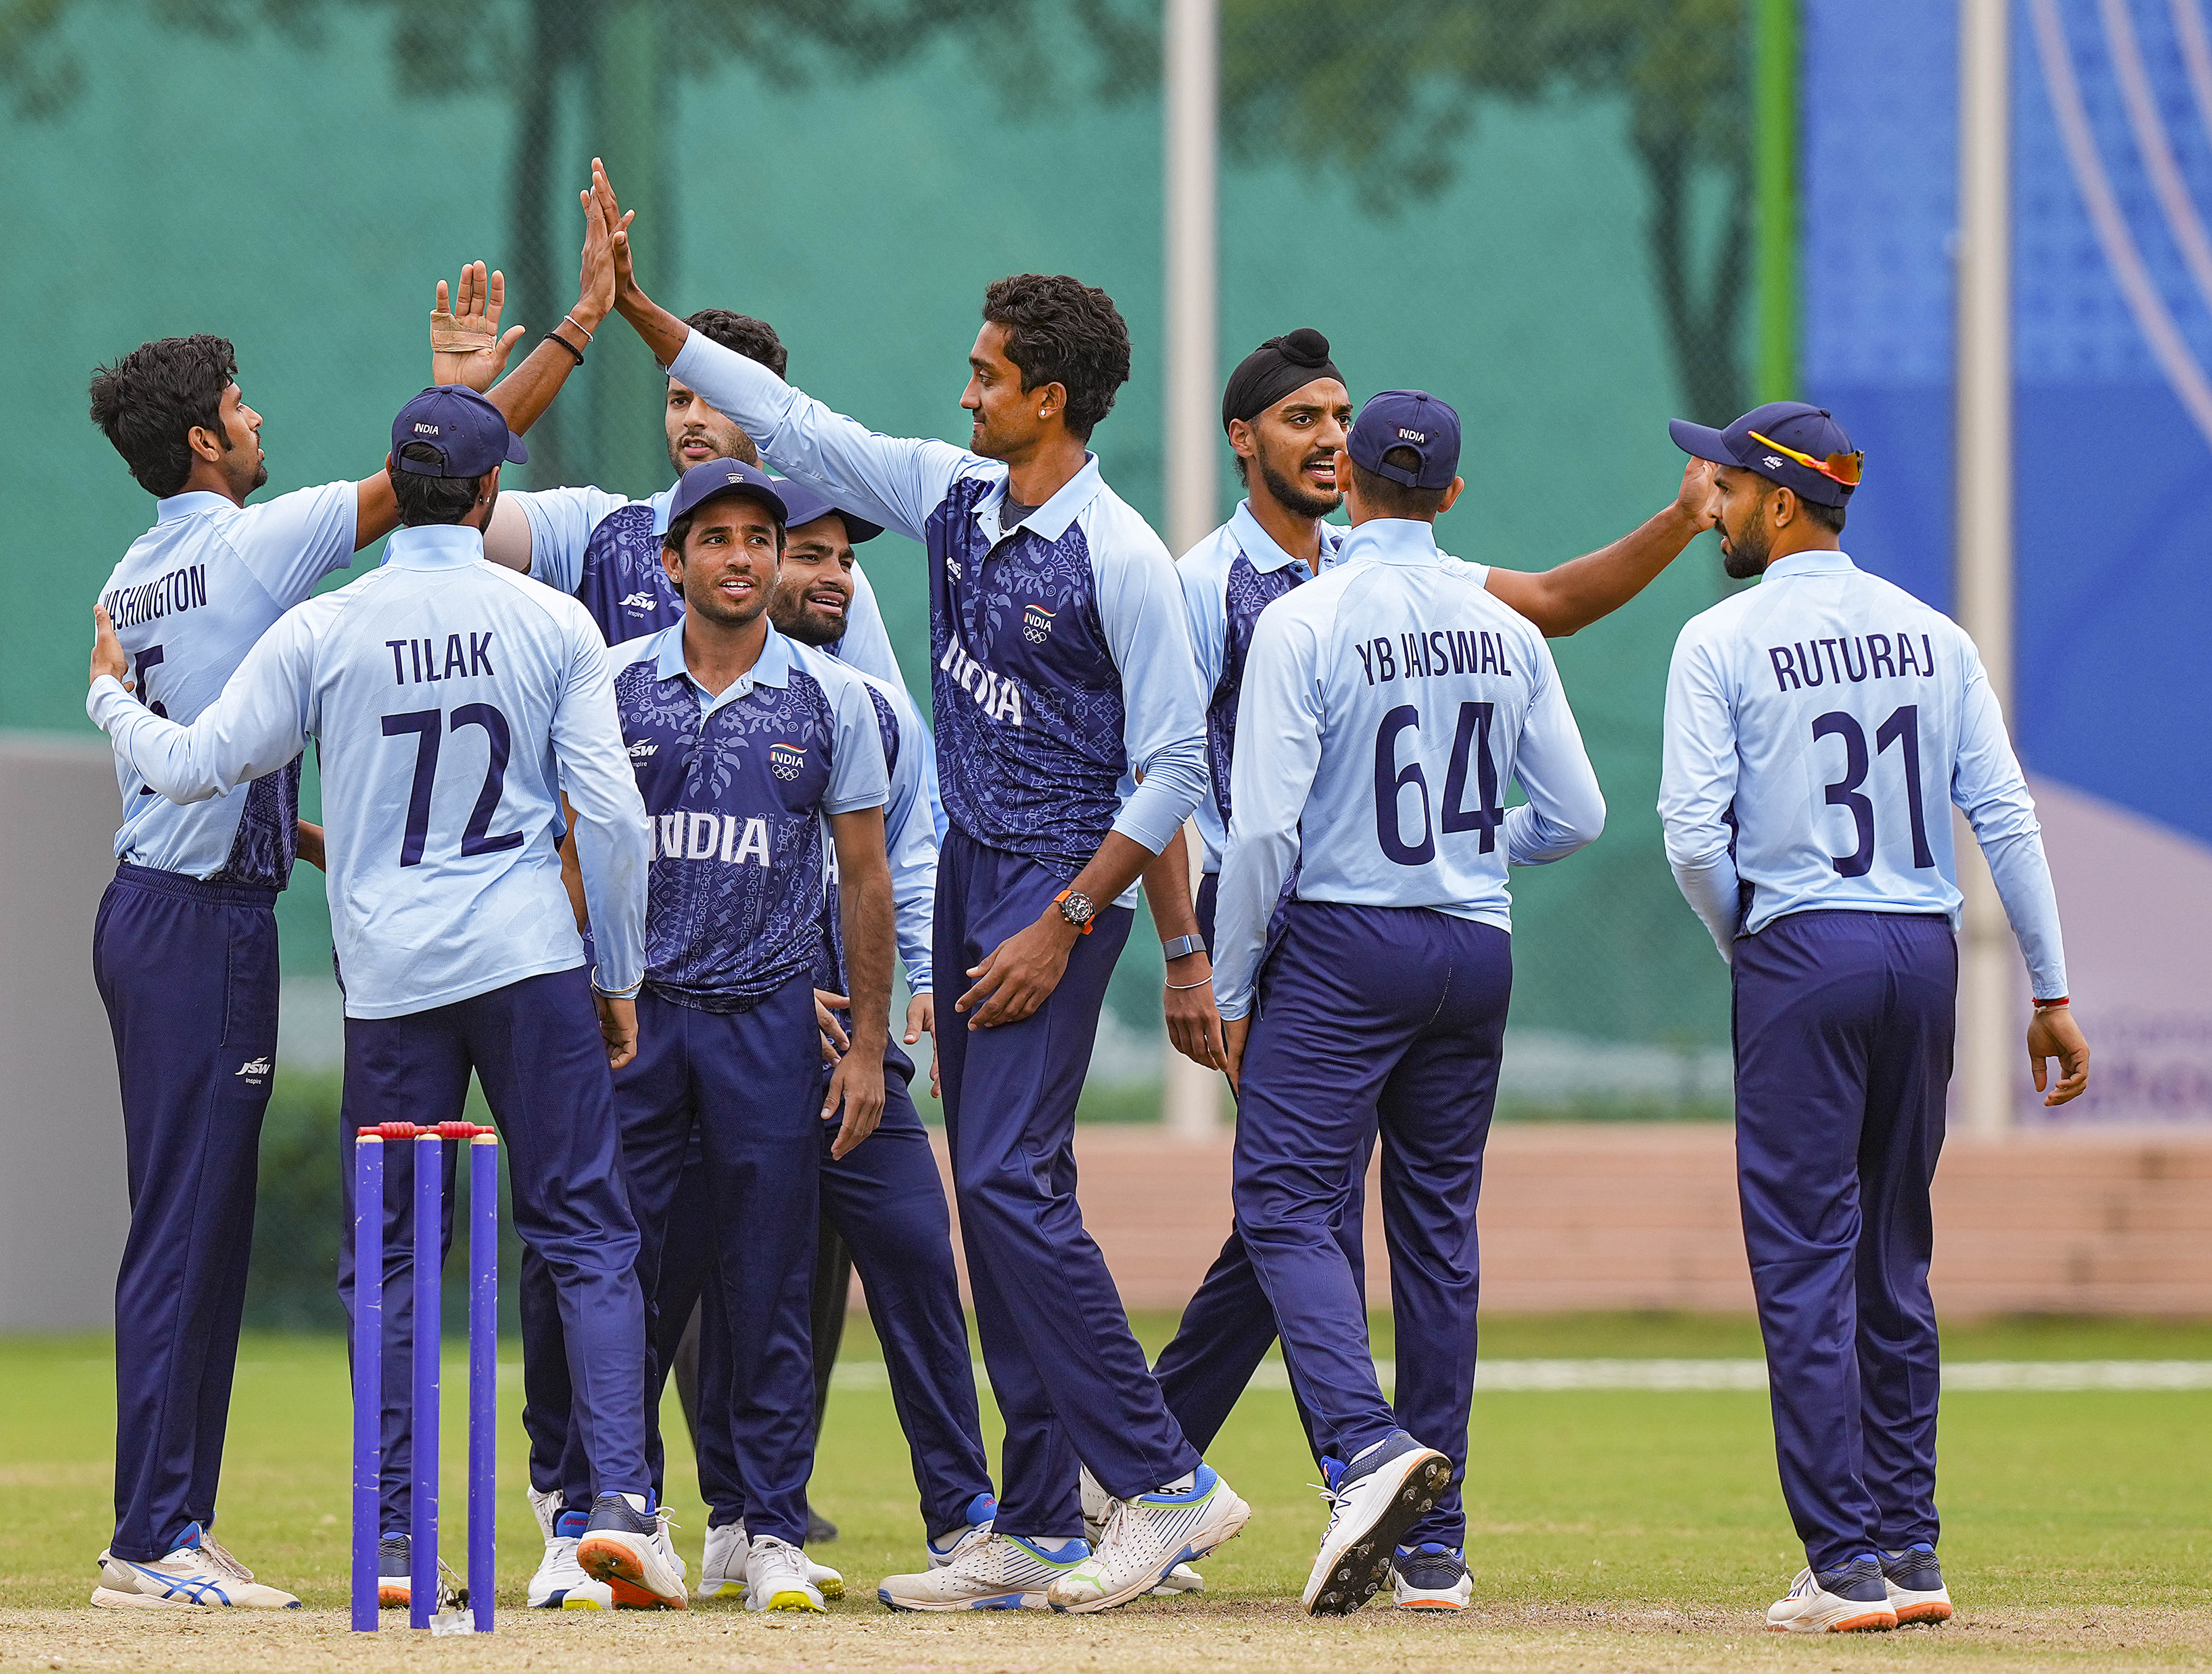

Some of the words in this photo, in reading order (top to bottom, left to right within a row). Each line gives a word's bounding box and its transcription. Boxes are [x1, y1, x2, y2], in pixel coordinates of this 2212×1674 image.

[414, 423, 439, 435] INDIA
[1398, 428, 1425, 443] INDIA
[618, 593, 658, 611] JSW
[627, 610, 644, 618] Inspire
[1024, 612, 1052, 632] INDIA
[386, 632, 494, 685] TILAK
[1355, 637, 1396, 686] YB
[1401, 630, 1512, 679] JAISWAL
[1768, 633, 1935, 692] RUTURAJ
[771, 751, 804, 769] INDIA
[381, 702, 524, 868] 72
[1374, 701, 1505, 866] 64
[1812, 705, 1936, 878] 31
[235, 1062, 271, 1075] JSW
